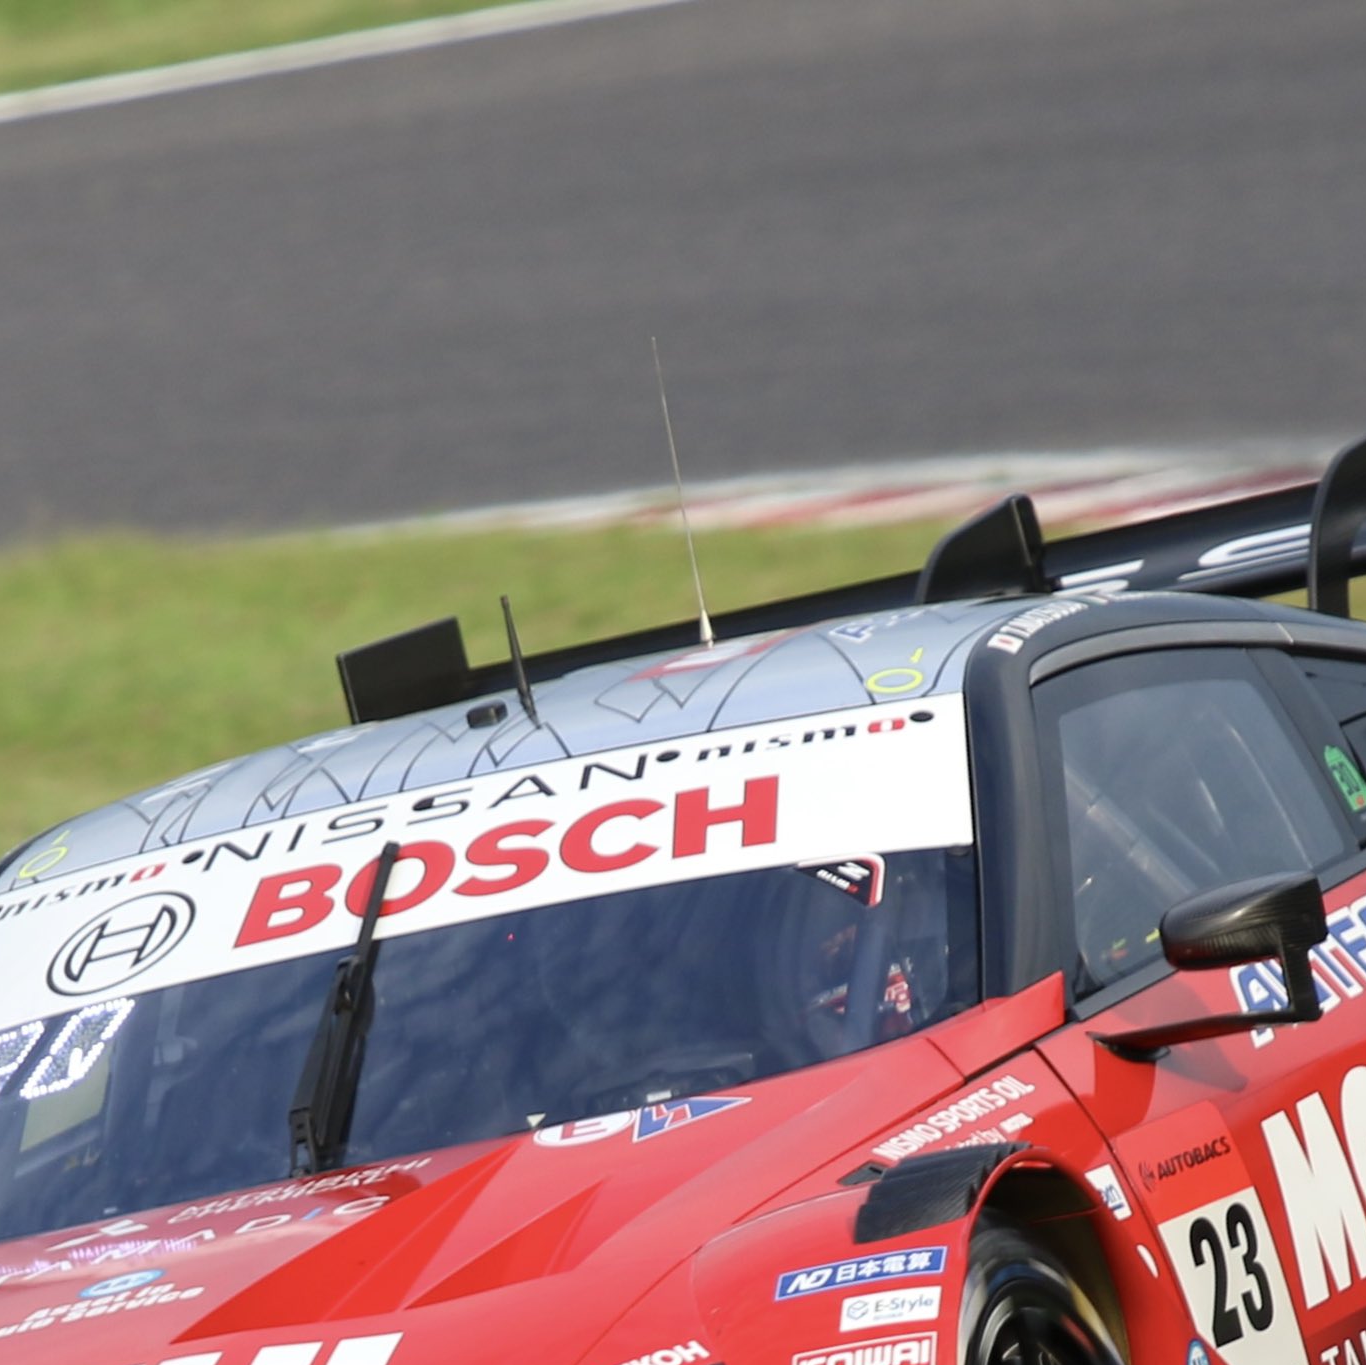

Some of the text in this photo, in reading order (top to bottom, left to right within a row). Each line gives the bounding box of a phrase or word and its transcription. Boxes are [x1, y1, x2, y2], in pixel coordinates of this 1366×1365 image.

[199, 749, 649, 871] NISSAN
[232, 774, 780, 950] BOSCH
[872, 1123, 943, 1161] NISMO
[927, 1087, 1008, 1133] SPORTS
[991, 1074, 1036, 1100] OIL
[1157, 1136, 1231, 1180] AUTOBACS
[873, 1294, 934, 1313] E-Style
[1189, 1204, 1274, 1349] 23
